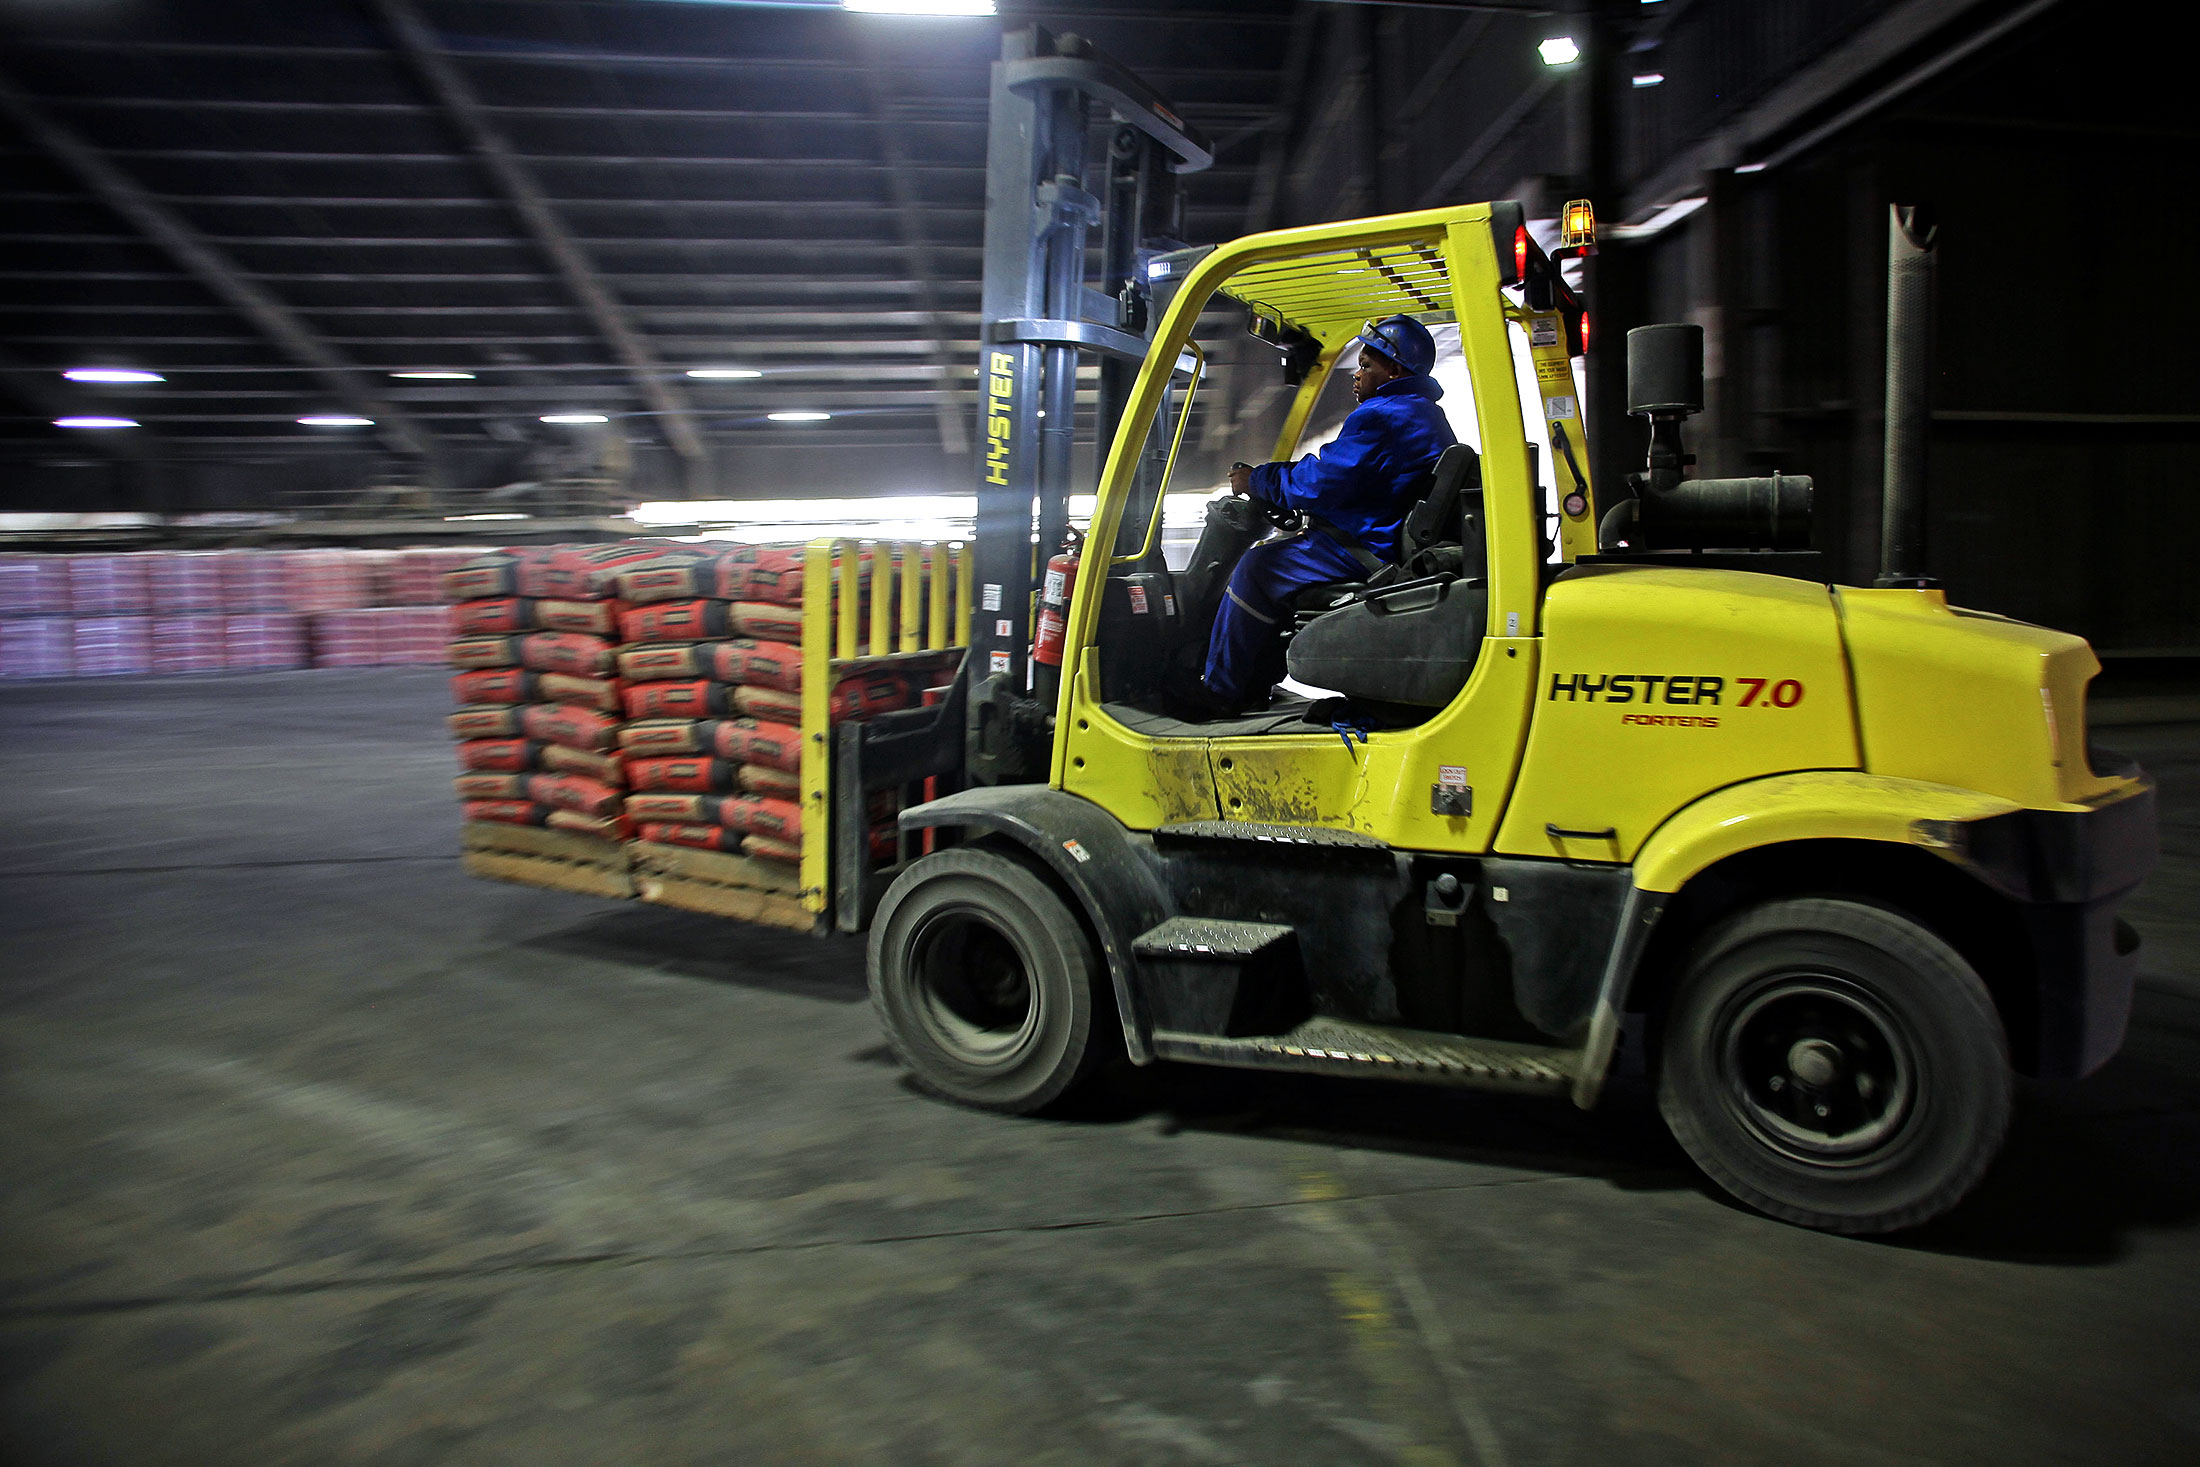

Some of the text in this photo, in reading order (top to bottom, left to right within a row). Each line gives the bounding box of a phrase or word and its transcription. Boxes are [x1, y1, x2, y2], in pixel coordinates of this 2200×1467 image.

[986, 352, 1015, 486] HYSTER
[1549, 673, 1803, 708] HYSTER 7.0
[1622, 714, 1720, 728] FORTENS
